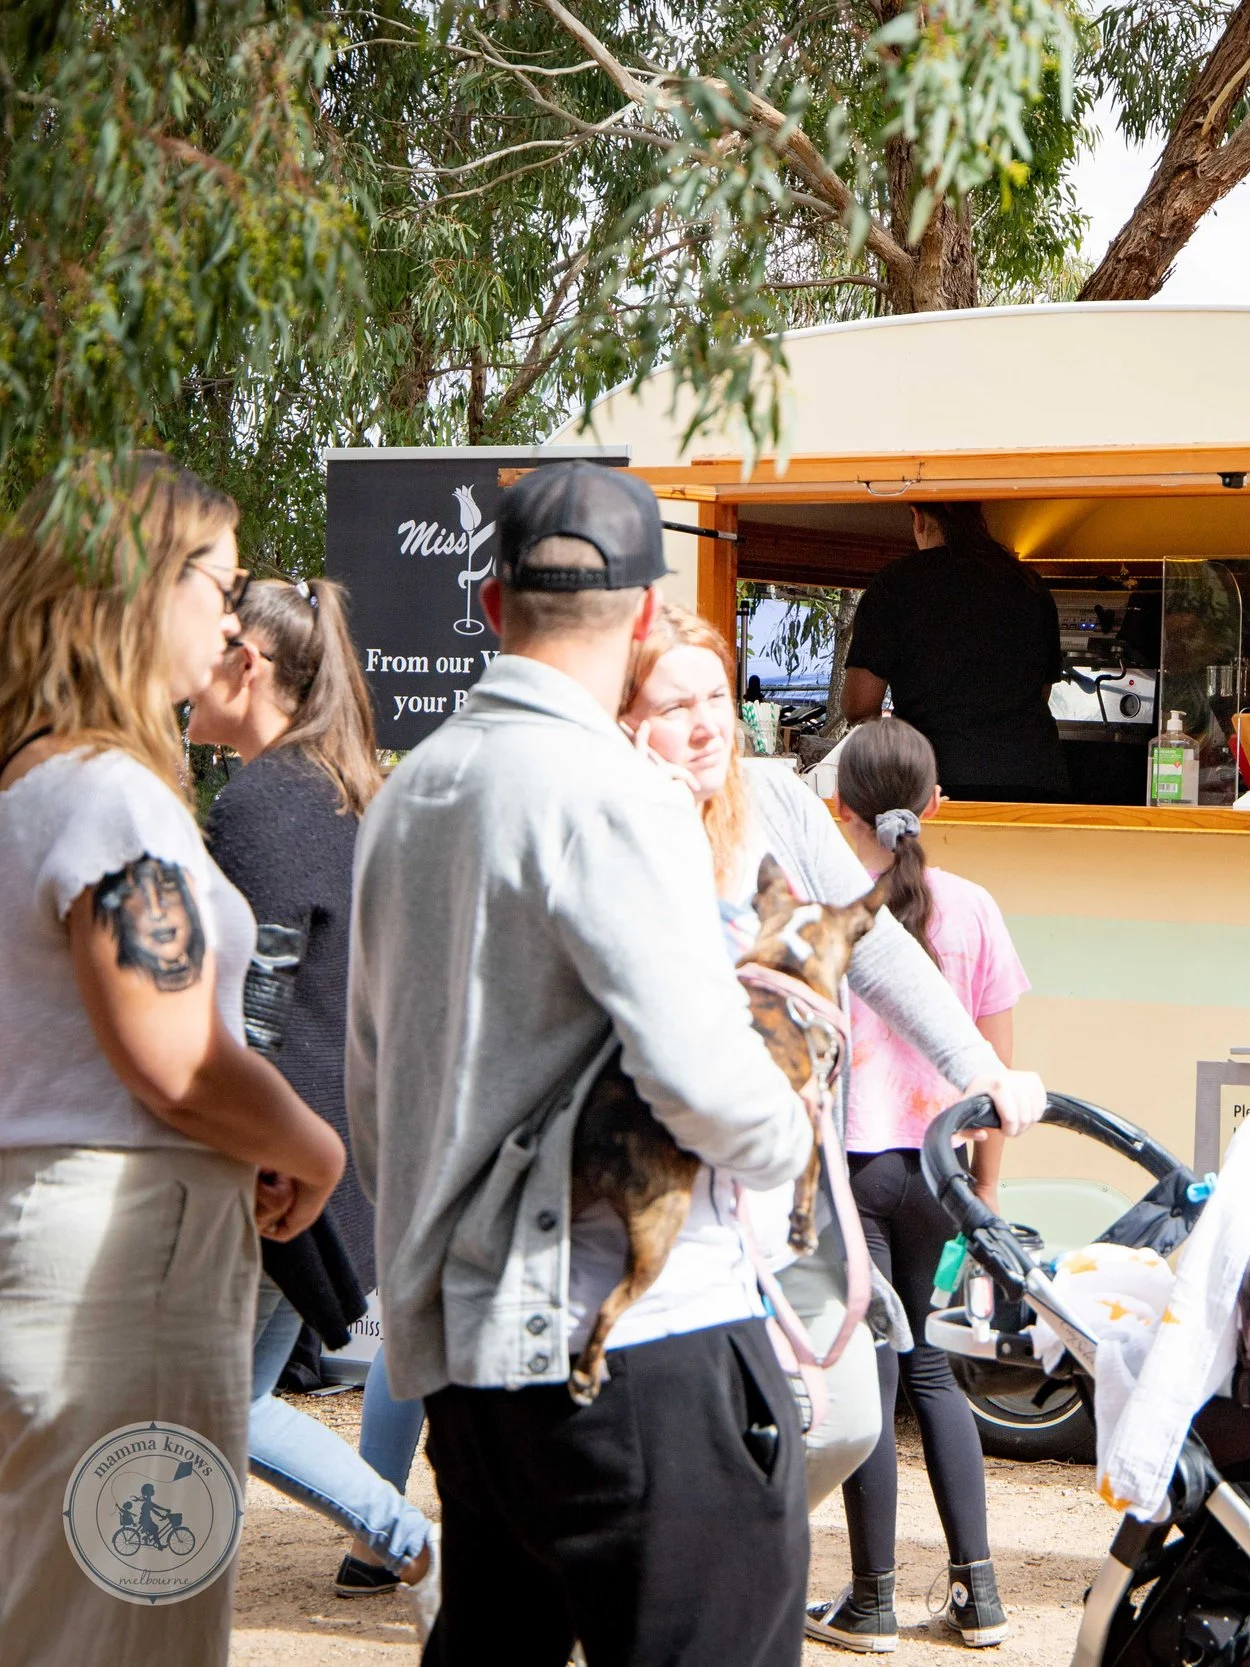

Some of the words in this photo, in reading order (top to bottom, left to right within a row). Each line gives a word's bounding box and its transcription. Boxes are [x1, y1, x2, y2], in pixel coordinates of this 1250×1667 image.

[397, 519, 471, 557] Miss
[365, 648, 429, 673] From
[435, 653, 474, 674] our
[393, 694, 447, 720] your
